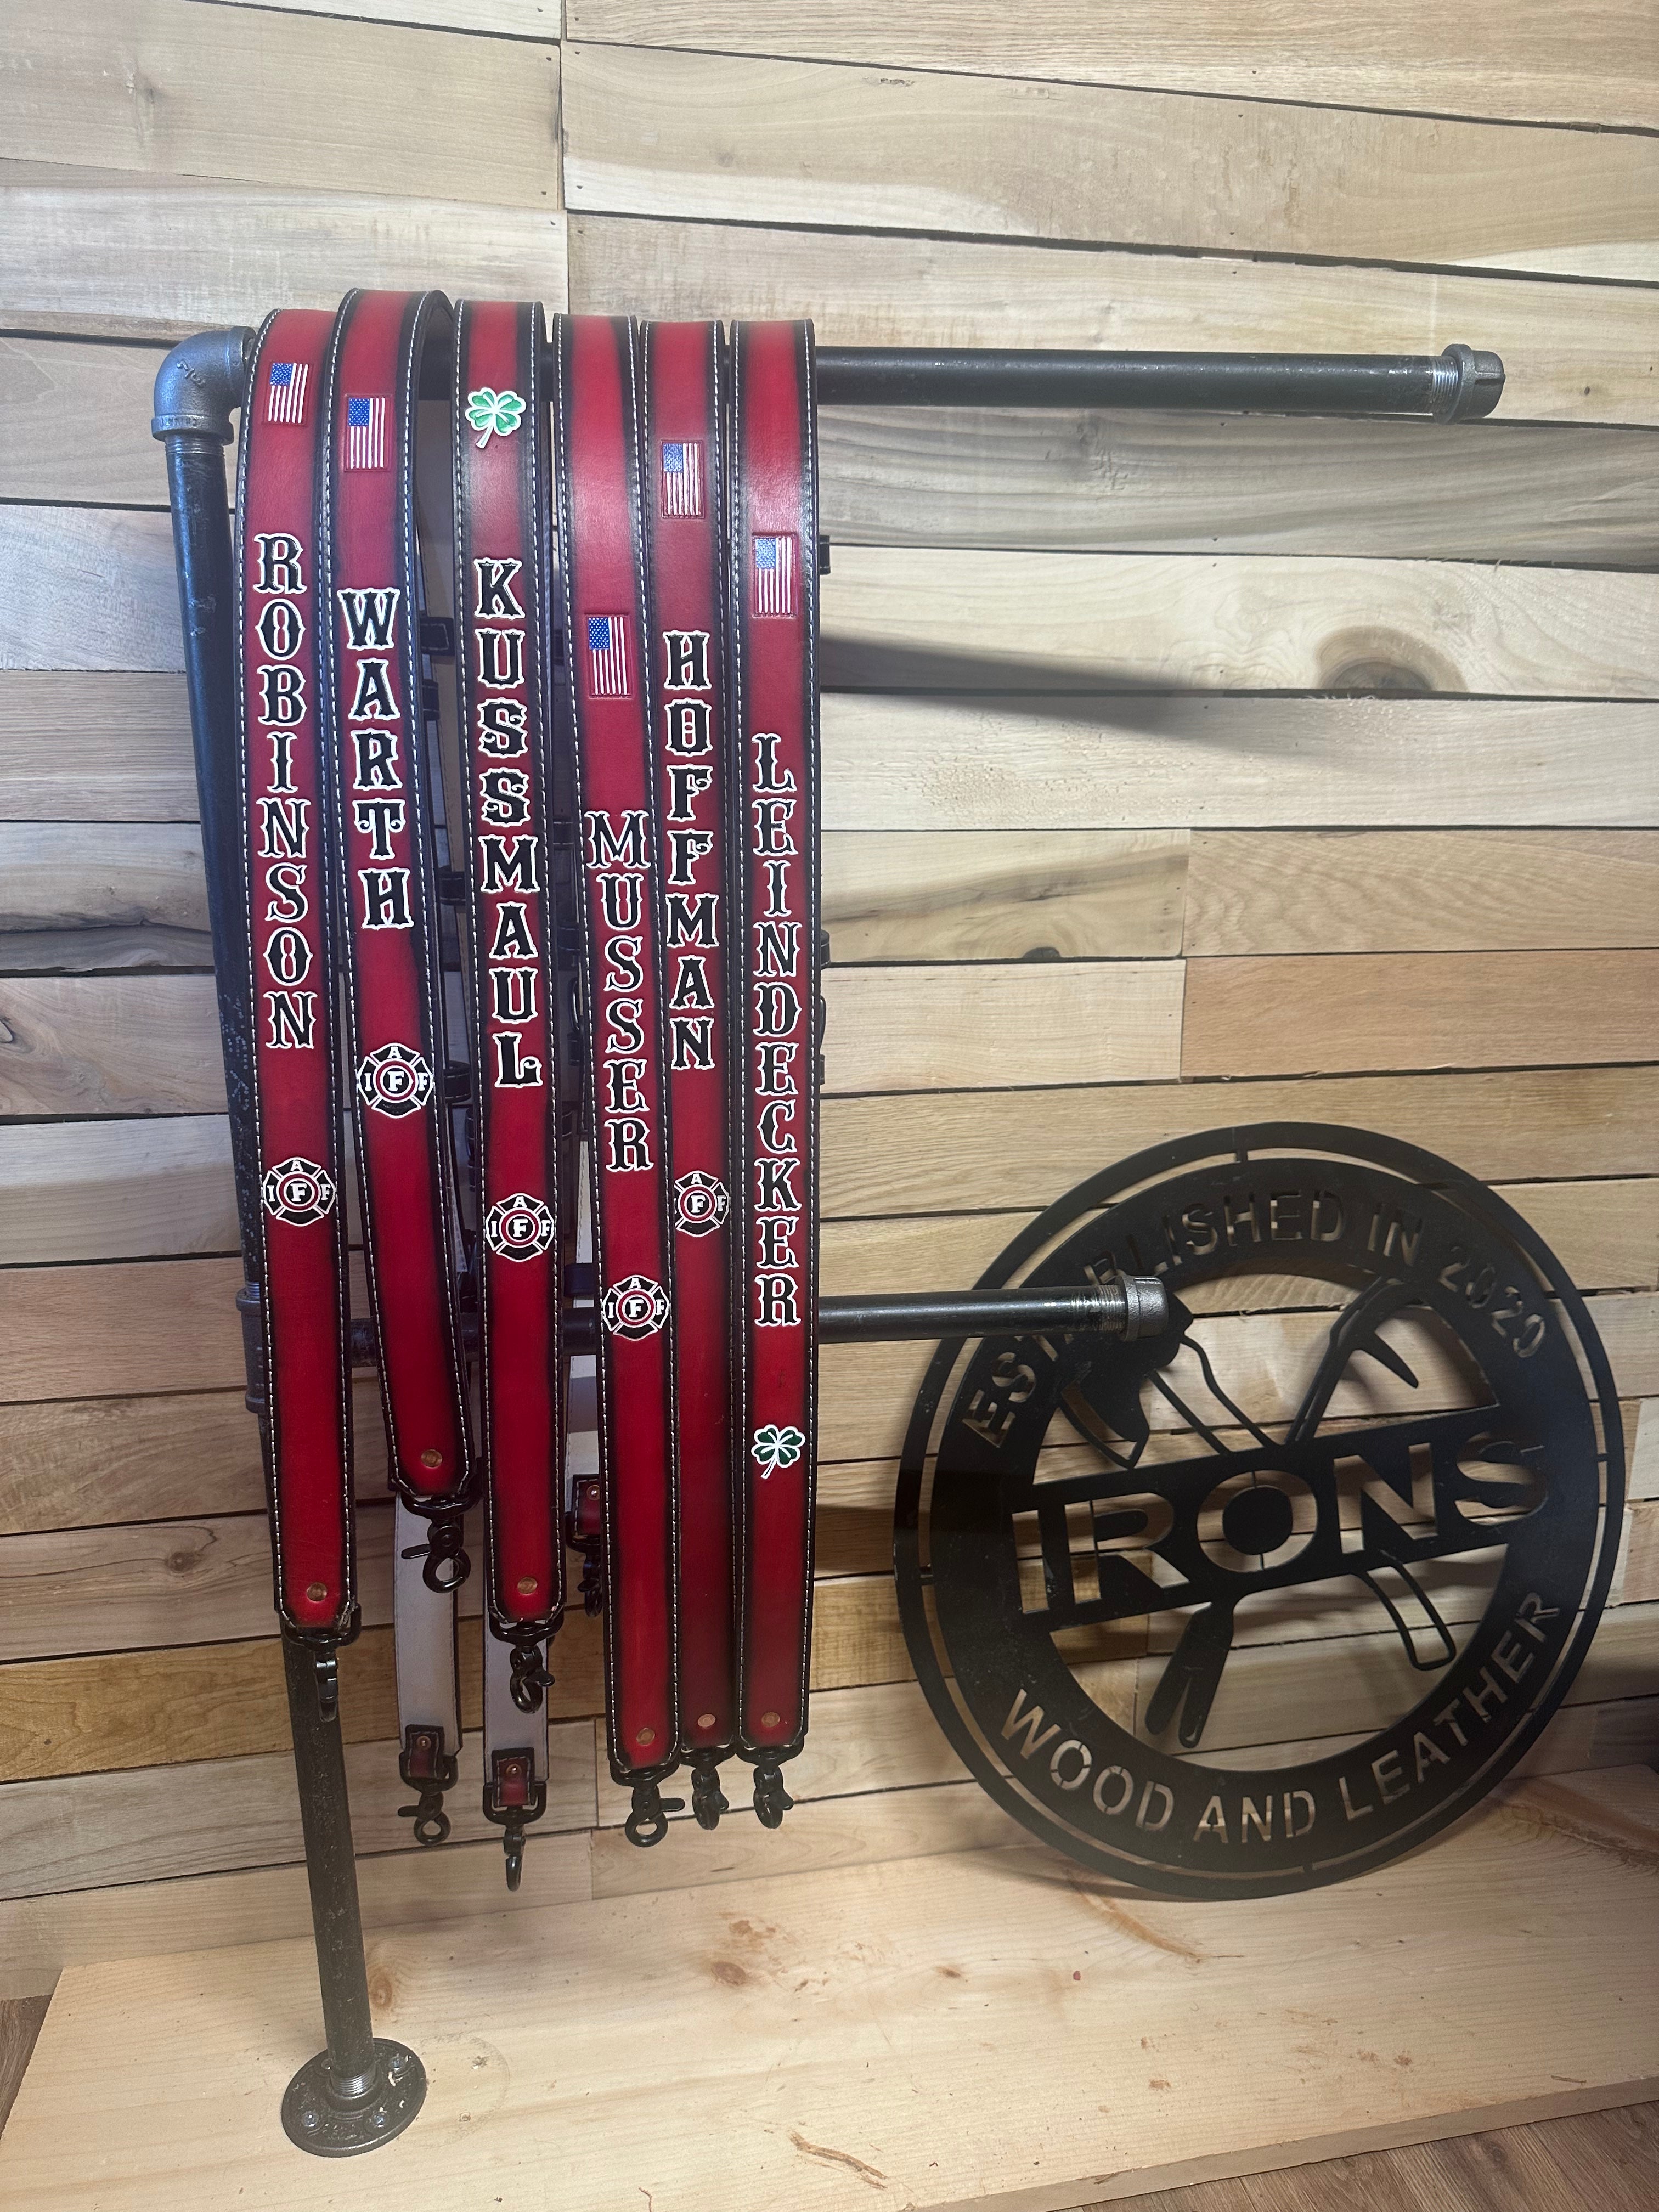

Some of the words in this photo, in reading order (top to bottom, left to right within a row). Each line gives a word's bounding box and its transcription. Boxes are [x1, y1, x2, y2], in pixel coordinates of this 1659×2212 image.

[253, 533, 315, 1049] ROBINSON
[337, 588, 414, 930] WARTH
[474, 558, 543, 1088] KUSSMAUL
[663, 630, 719, 1070] HOFFMAN
[584, 810, 653, 1173] MUSSER
[752, 732, 802, 1327] LEINDECKER
[1368, 1203, 1423, 1266] IN
[1438, 1245, 1545, 1358] 2020
[1012, 1430, 1549, 1614] IRONS
[1001, 1688, 1174, 1832] WOOD
[1192, 1790, 1317, 1843] AND
[1339, 1592, 1560, 1821] LEATHER
